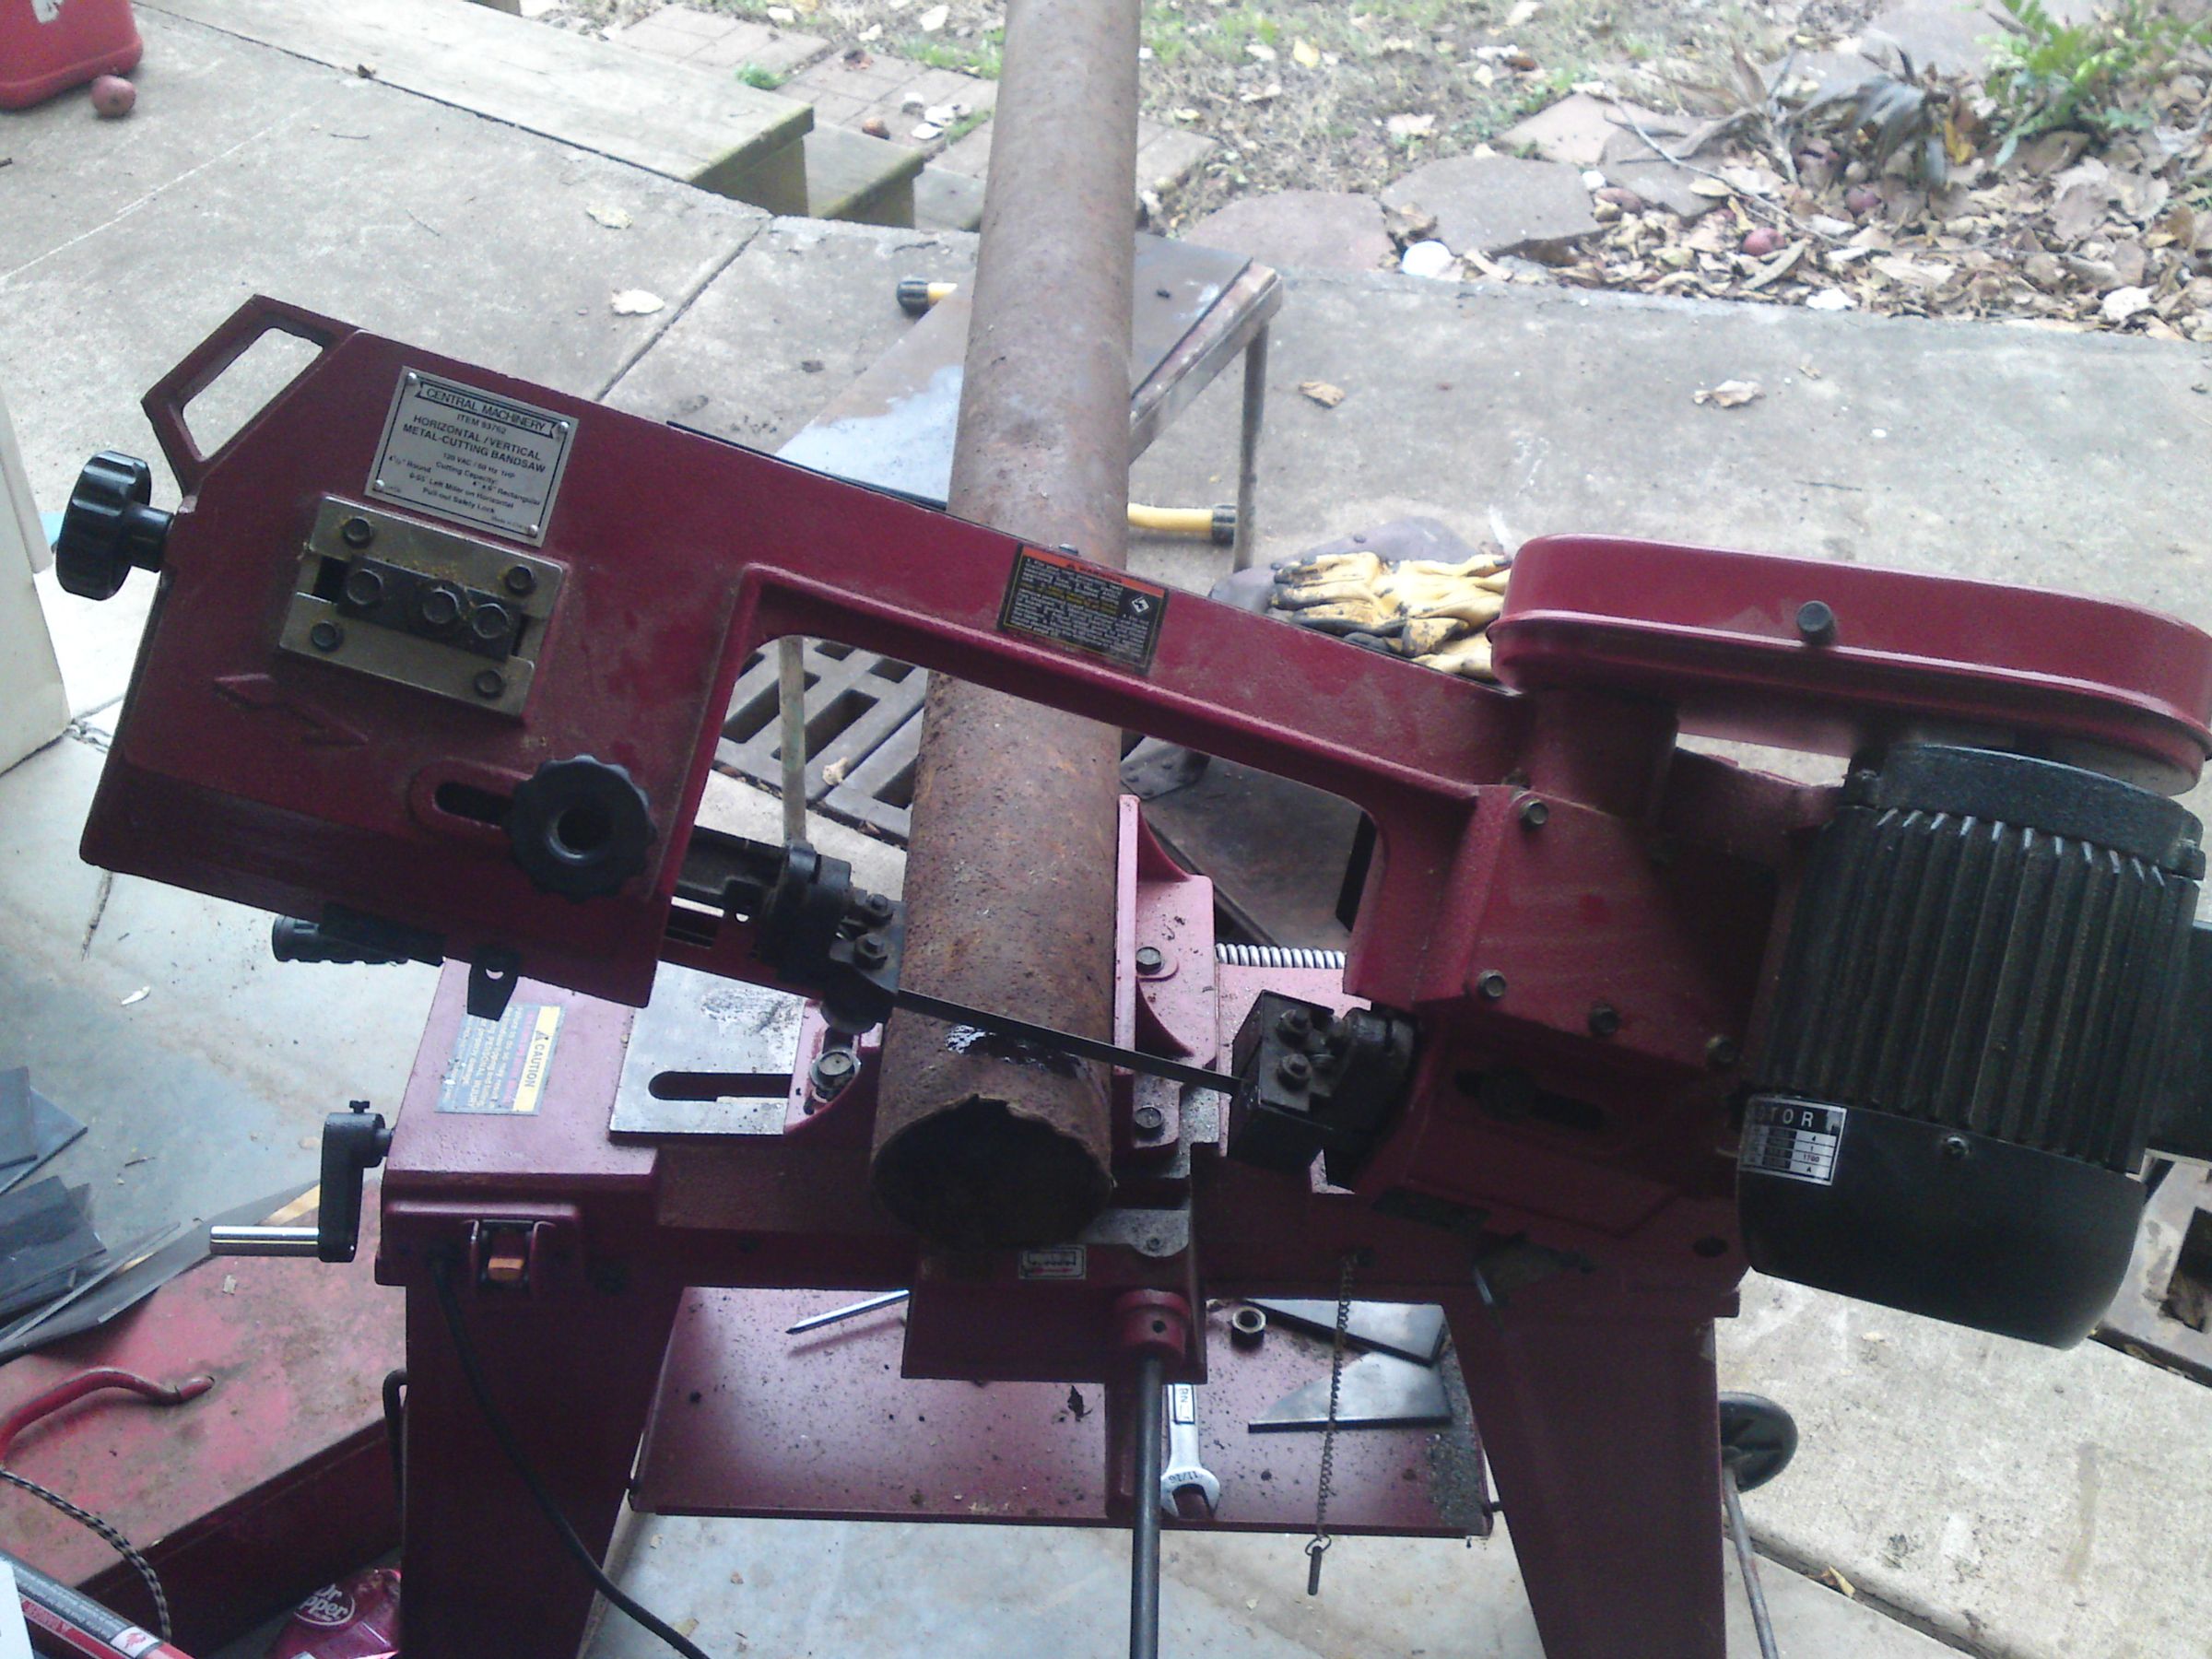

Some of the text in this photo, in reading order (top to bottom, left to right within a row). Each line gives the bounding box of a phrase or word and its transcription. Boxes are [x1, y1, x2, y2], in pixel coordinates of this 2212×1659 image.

[426, 387, 546, 431] CENTRAL MACHINERY
[456, 413, 479, 426] ITEM
[412, 414, 482, 441] HORIZONTAL
[402, 423, 546, 473] METAL-CUTTING BANDSAW
[434, 461, 463, 476] Cutting
[496, 487, 541, 507] Rectangular
[524, 1042, 545, 1088] CAUTION
[299, 1595, 348, 1618] pper
